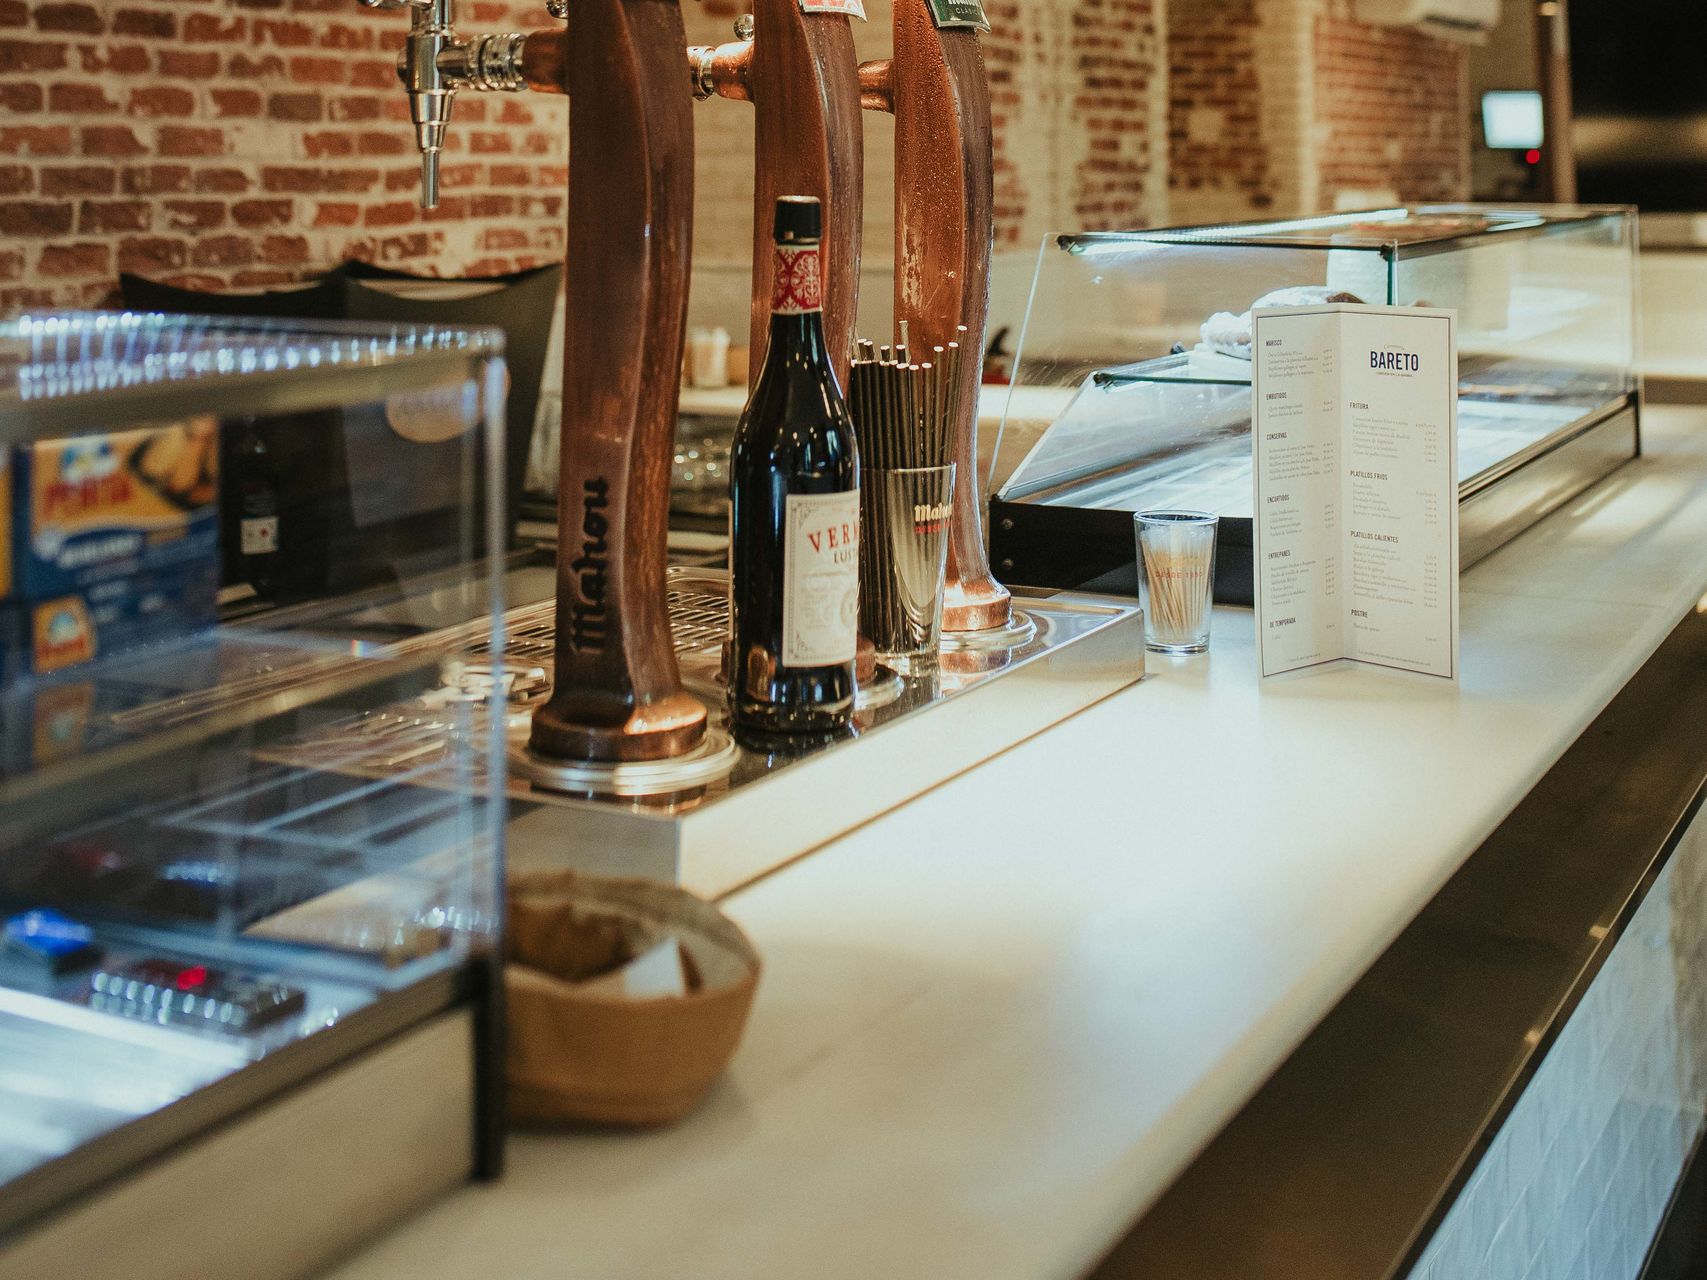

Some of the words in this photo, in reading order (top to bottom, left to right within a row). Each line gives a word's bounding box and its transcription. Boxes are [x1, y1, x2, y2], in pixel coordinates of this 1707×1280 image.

[1370, 350, 1419, 371] BARETO
[1266, 392, 1287, 401] EMBUTIDOS
[1349, 402, 1369, 410] FRITURA
[1266, 432, 1287, 440] CONSERVAS
[1350, 470, 1373, 479] PLATILLOS
[1350, 530, 1373, 539] PLATILLOS
[1374, 534, 1399, 543] CALIENTES
[1351, 609, 1368, 618] POSTRE
[1275, 617, 1297, 626] TEMPORADA
